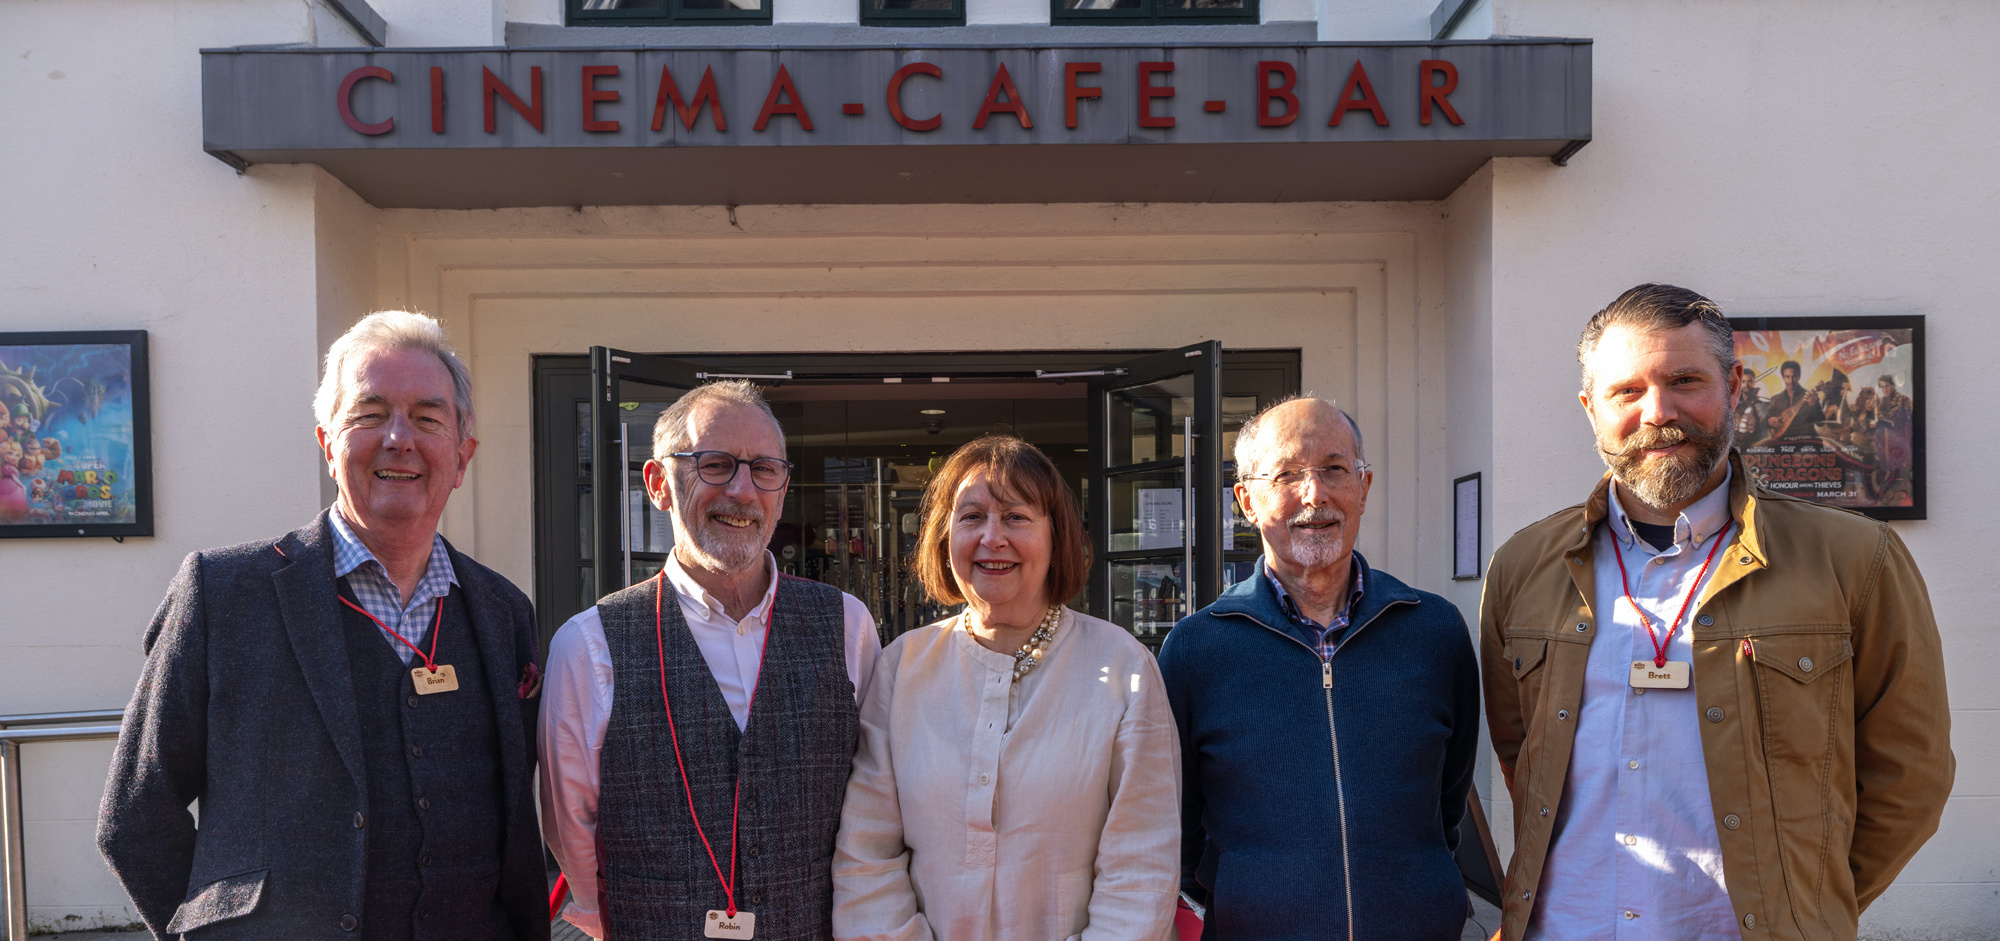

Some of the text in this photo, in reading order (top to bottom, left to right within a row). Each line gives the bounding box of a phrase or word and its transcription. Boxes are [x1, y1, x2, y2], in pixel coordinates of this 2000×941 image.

[74, 460, 106, 470] SUPER
[1742, 454, 1837, 468] DUNGEONS
[57, 469, 118, 486] MARIO
[1762, 468, 1843, 481] DRAGONS
[83, 500, 113, 508] MOVIE
[1648, 671, 1671, 680] Brett
[427, 677, 445, 685] Brian
[719, 921, 741, 931] Robin
